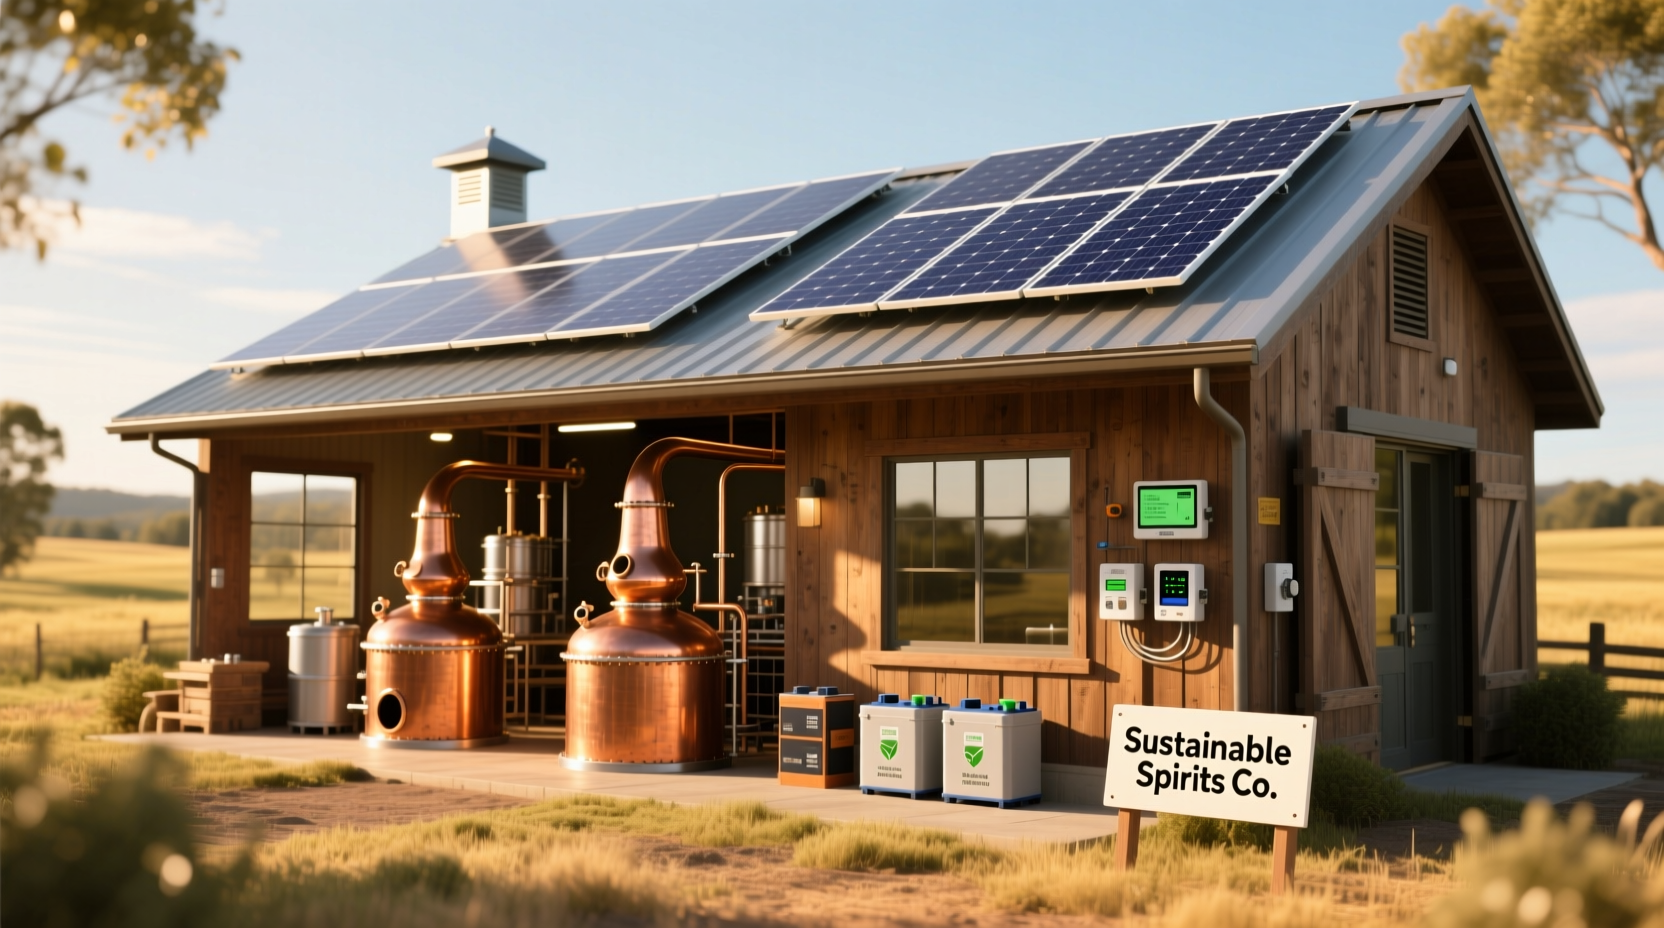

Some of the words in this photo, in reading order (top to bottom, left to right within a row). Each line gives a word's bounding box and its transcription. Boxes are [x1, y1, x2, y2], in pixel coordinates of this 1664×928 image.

[1123, 726, 1292, 766] Sustainable
[1136, 760, 1226, 796] Spirits
[1231, 768, 1277, 800] Co.
